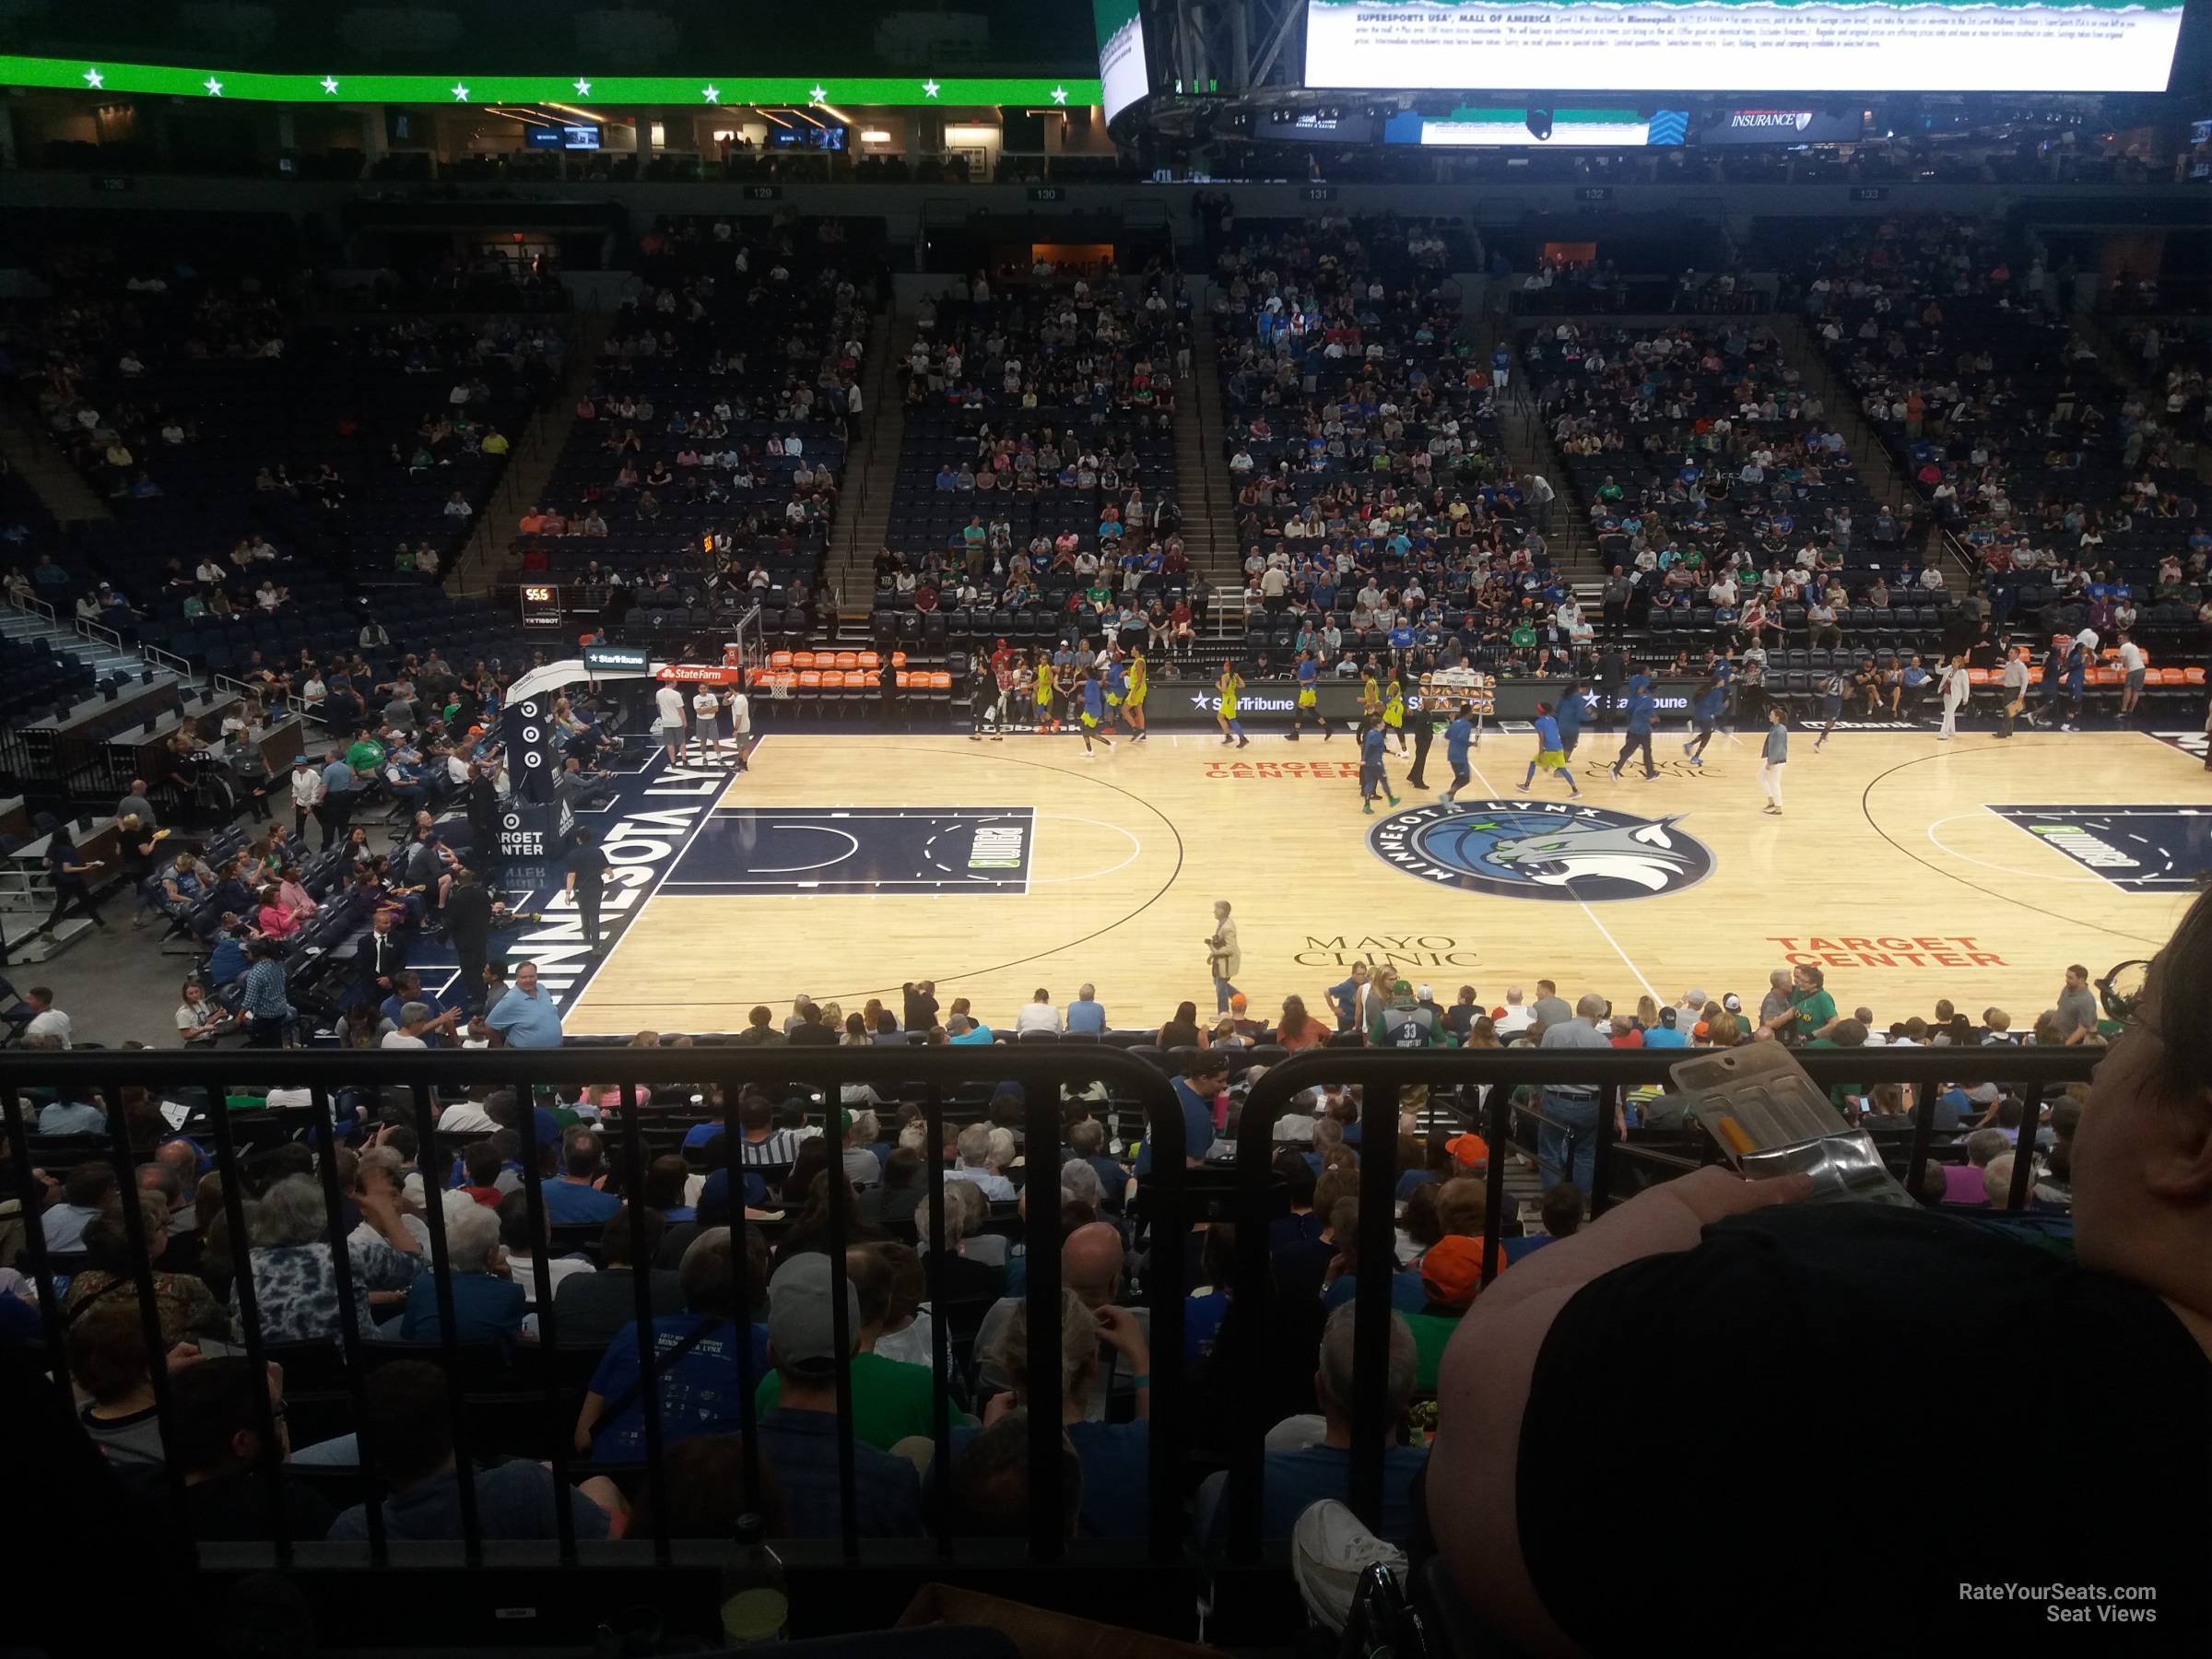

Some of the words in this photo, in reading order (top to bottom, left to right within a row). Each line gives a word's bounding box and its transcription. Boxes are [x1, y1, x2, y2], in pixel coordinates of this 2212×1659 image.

[1357, 14, 1424, 22] SUPERSPORTS
[1507, 15, 1551, 23] AMERICA
[1731, 113, 1795, 127] INSURANCE
[754, 187, 772, 199] 129
[1038, 189, 1055, 200] 130
[1311, 189, 1327, 200] 131
[1585, 189, 1604, 200] 132
[598, 654, 643, 664] StarTribune
[1203, 761, 1363, 771] TARGET
[1206, 771, 1360, 779] CENTER
[1486, 801, 1602, 818] LYNX
[500, 844, 544, 855] NTER
[1304, 935, 1456, 949] MAYO
[1765, 936, 1979, 951] TARGET
[1293, 952, 1483, 967] CLINIC
[1784, 953, 2011, 967] CENTER
[1404, 1023, 1417, 1039] 33
